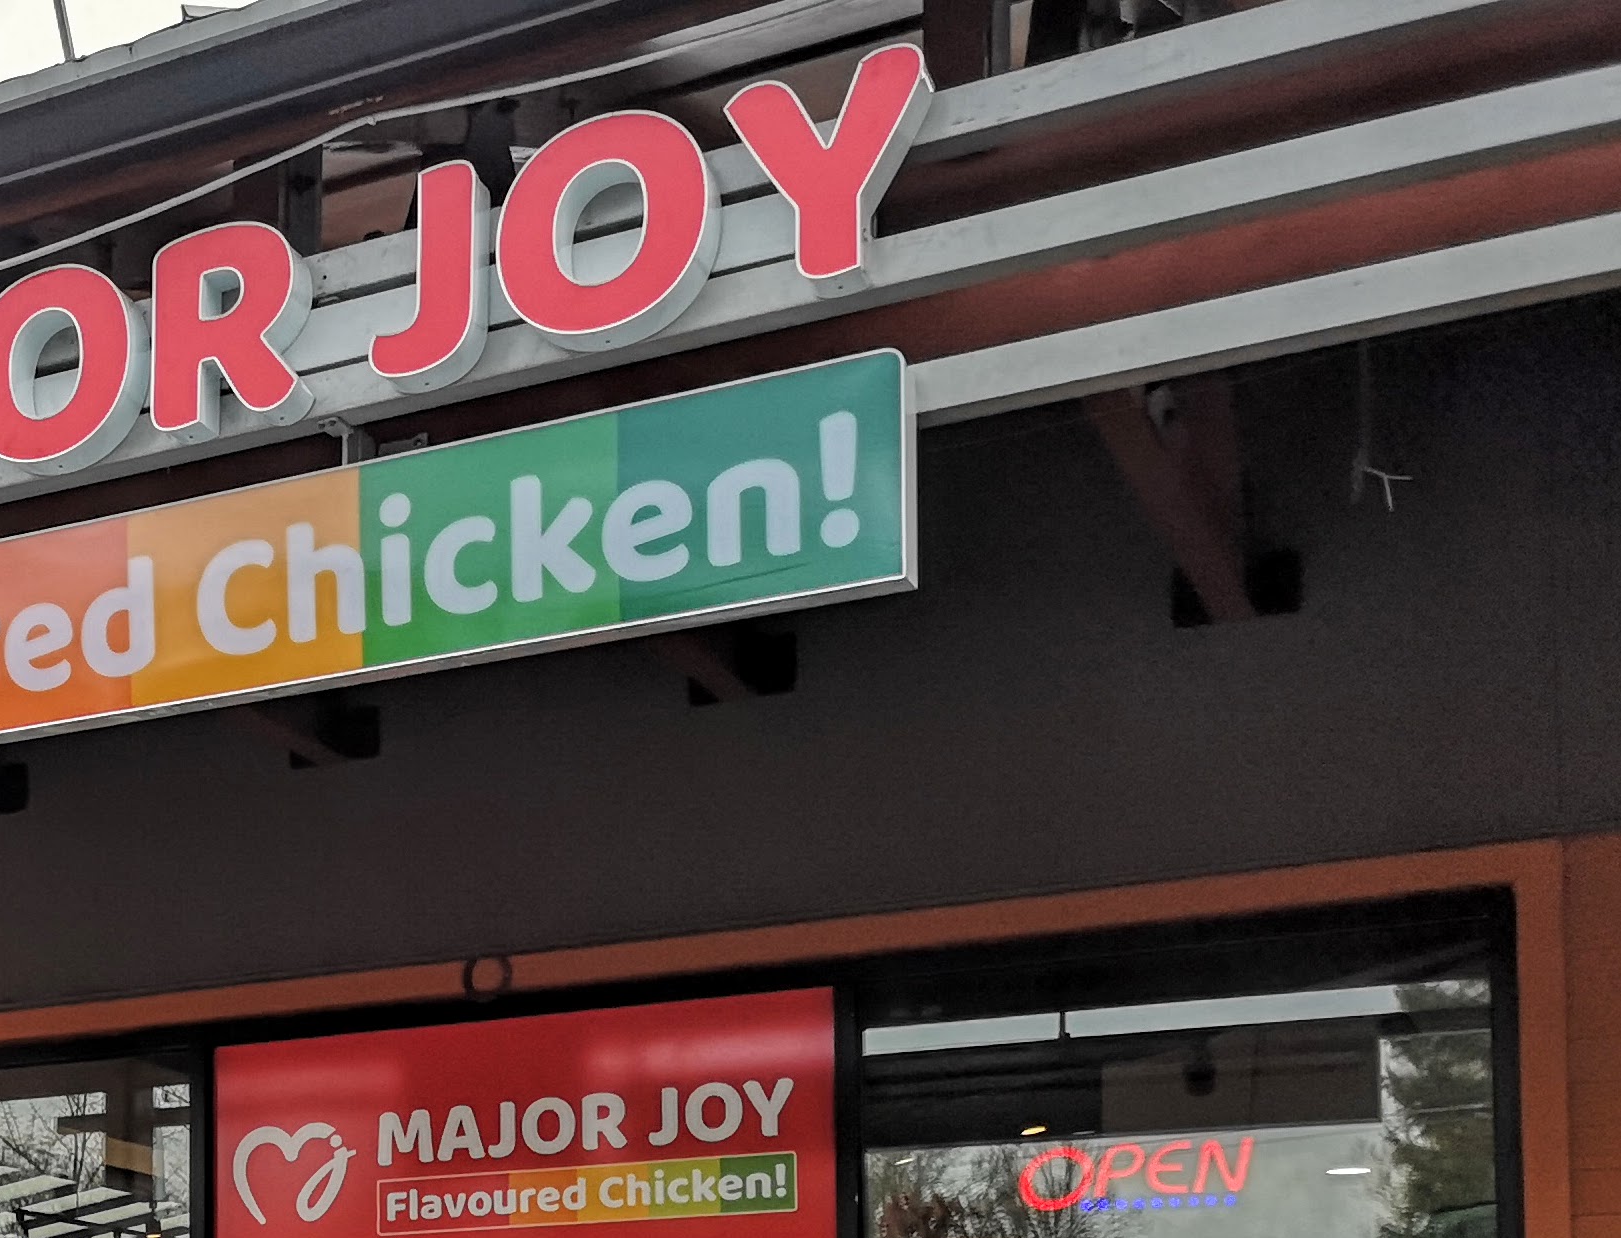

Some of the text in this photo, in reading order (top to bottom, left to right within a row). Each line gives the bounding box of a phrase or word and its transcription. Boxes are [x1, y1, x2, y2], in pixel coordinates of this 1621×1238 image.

[368, 43, 926, 382] JOY
[196, 410, 860, 655] Chicken!
[377, 1077, 795, 1167] MAJOR JOY
[386, 1163, 788, 1221] Flavoured Chicken!
[1018, 1136, 1255, 1212] OPEN
